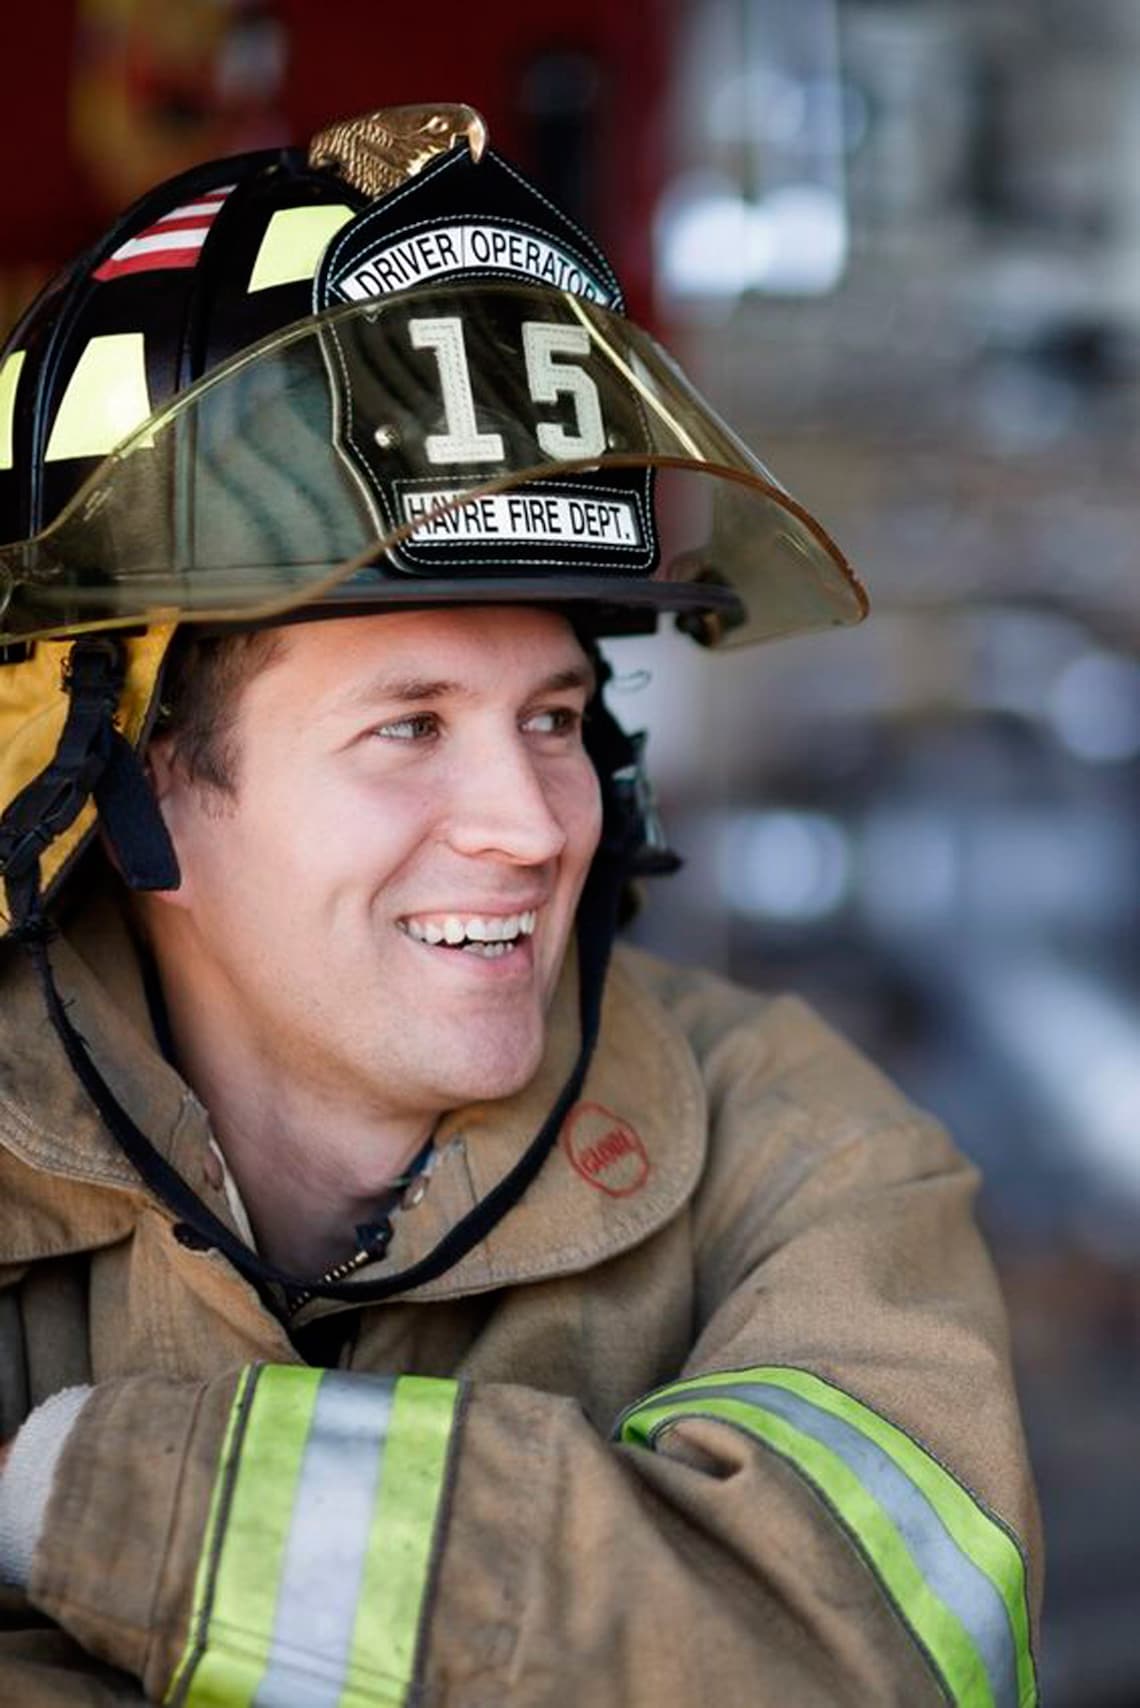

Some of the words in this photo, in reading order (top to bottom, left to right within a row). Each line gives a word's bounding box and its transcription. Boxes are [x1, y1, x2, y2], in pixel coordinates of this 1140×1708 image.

[355, 233, 459, 299] DRIVER
[408, 317, 606, 462] 15
[407, 496, 498, 534] HAVRE
[507, 499, 561, 532] FIRE
[569, 502, 631, 540] DEPT.
